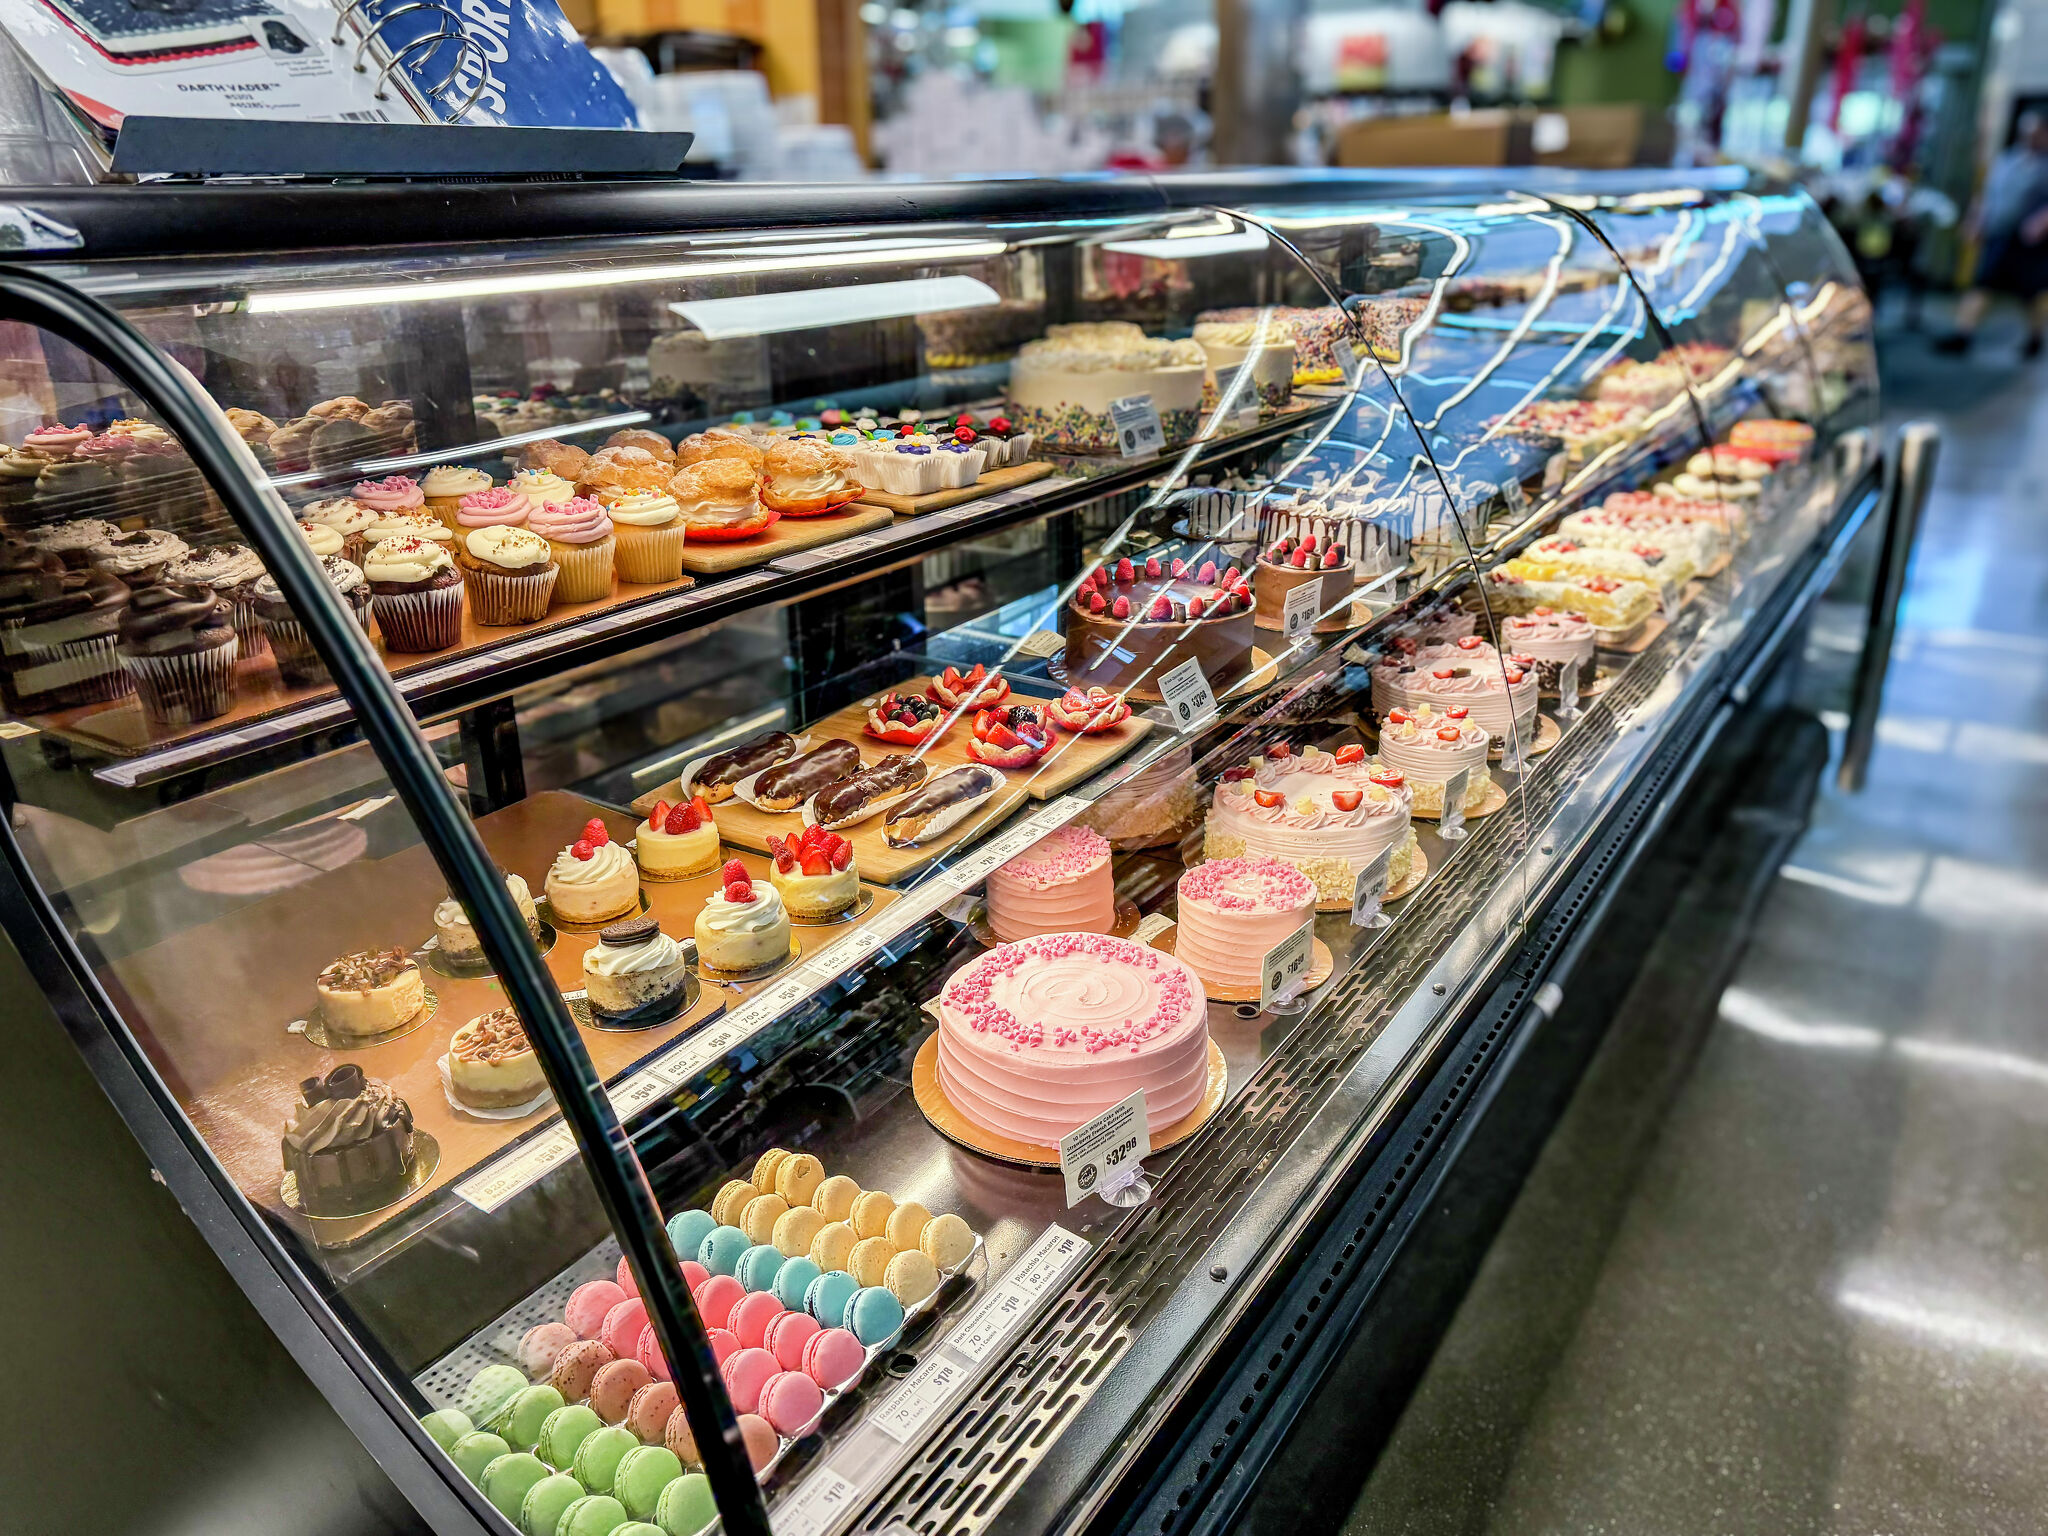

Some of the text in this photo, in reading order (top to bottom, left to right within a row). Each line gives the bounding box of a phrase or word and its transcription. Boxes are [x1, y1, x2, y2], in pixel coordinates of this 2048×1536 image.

[454, 0, 511, 115] SPOR
[177, 83, 226, 92] DARTH
[741, 1011, 760, 1024] 700
[708, 1032, 732, 1048] $548
[668, 1060, 687, 1074] 800
[630, 1083, 657, 1100] $548
[1089, 1121, 1102, 1131] White
[1102, 1113, 1114, 1123] Cake
[1067, 1134, 1091, 1152] Strawberry
[1091, 1123, 1107, 1137] French
[1106, 1136, 1137, 1166] $3298
[1058, 1238, 1075, 1254] $178
[1015, 1235, 1060, 1282] Pistachio Macaron
[1029, 1273, 1041, 1284] 80
[1001, 1295, 1020, 1313] $178
[954, 1292, 1003, 1344] Dark Chocolate Macaron
[968, 1334, 982, 1346] 70
[933, 1367, 953, 1386] $178
[880, 1362, 938, 1420] Raspberry Macaron
[896, 1409, 909, 1421] 70
[823, 1481, 846, 1503] $178
